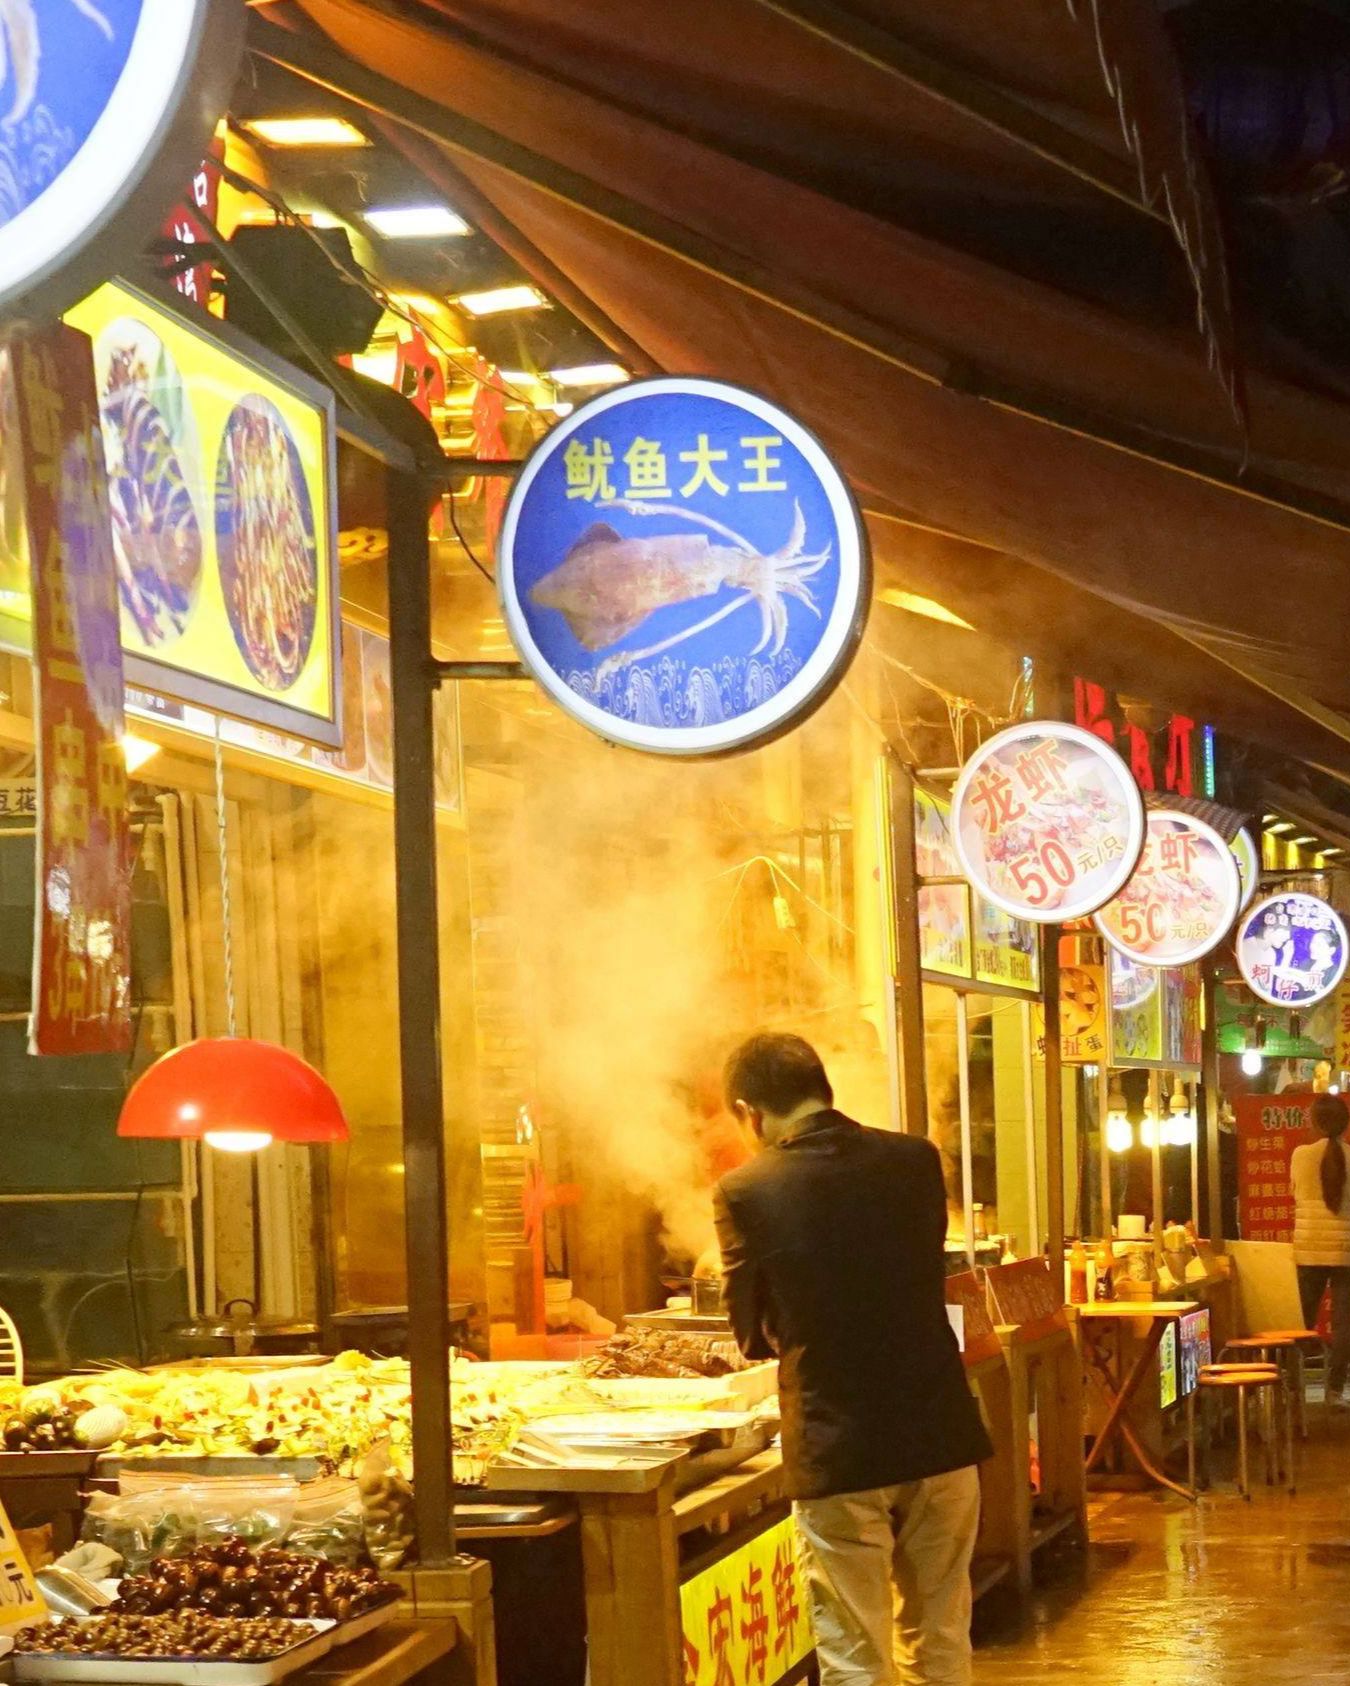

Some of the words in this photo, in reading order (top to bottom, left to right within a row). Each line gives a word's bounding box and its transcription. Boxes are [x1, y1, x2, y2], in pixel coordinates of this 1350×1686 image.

[563, 433, 788, 502] 鱿鱼大王
[970, 737, 1071, 837] 龙虾
[1008, 839, 1076, 905] 50
[1076, 834, 1124, 876] 元/只
[1261, 1105, 1312, 1131] 特价
